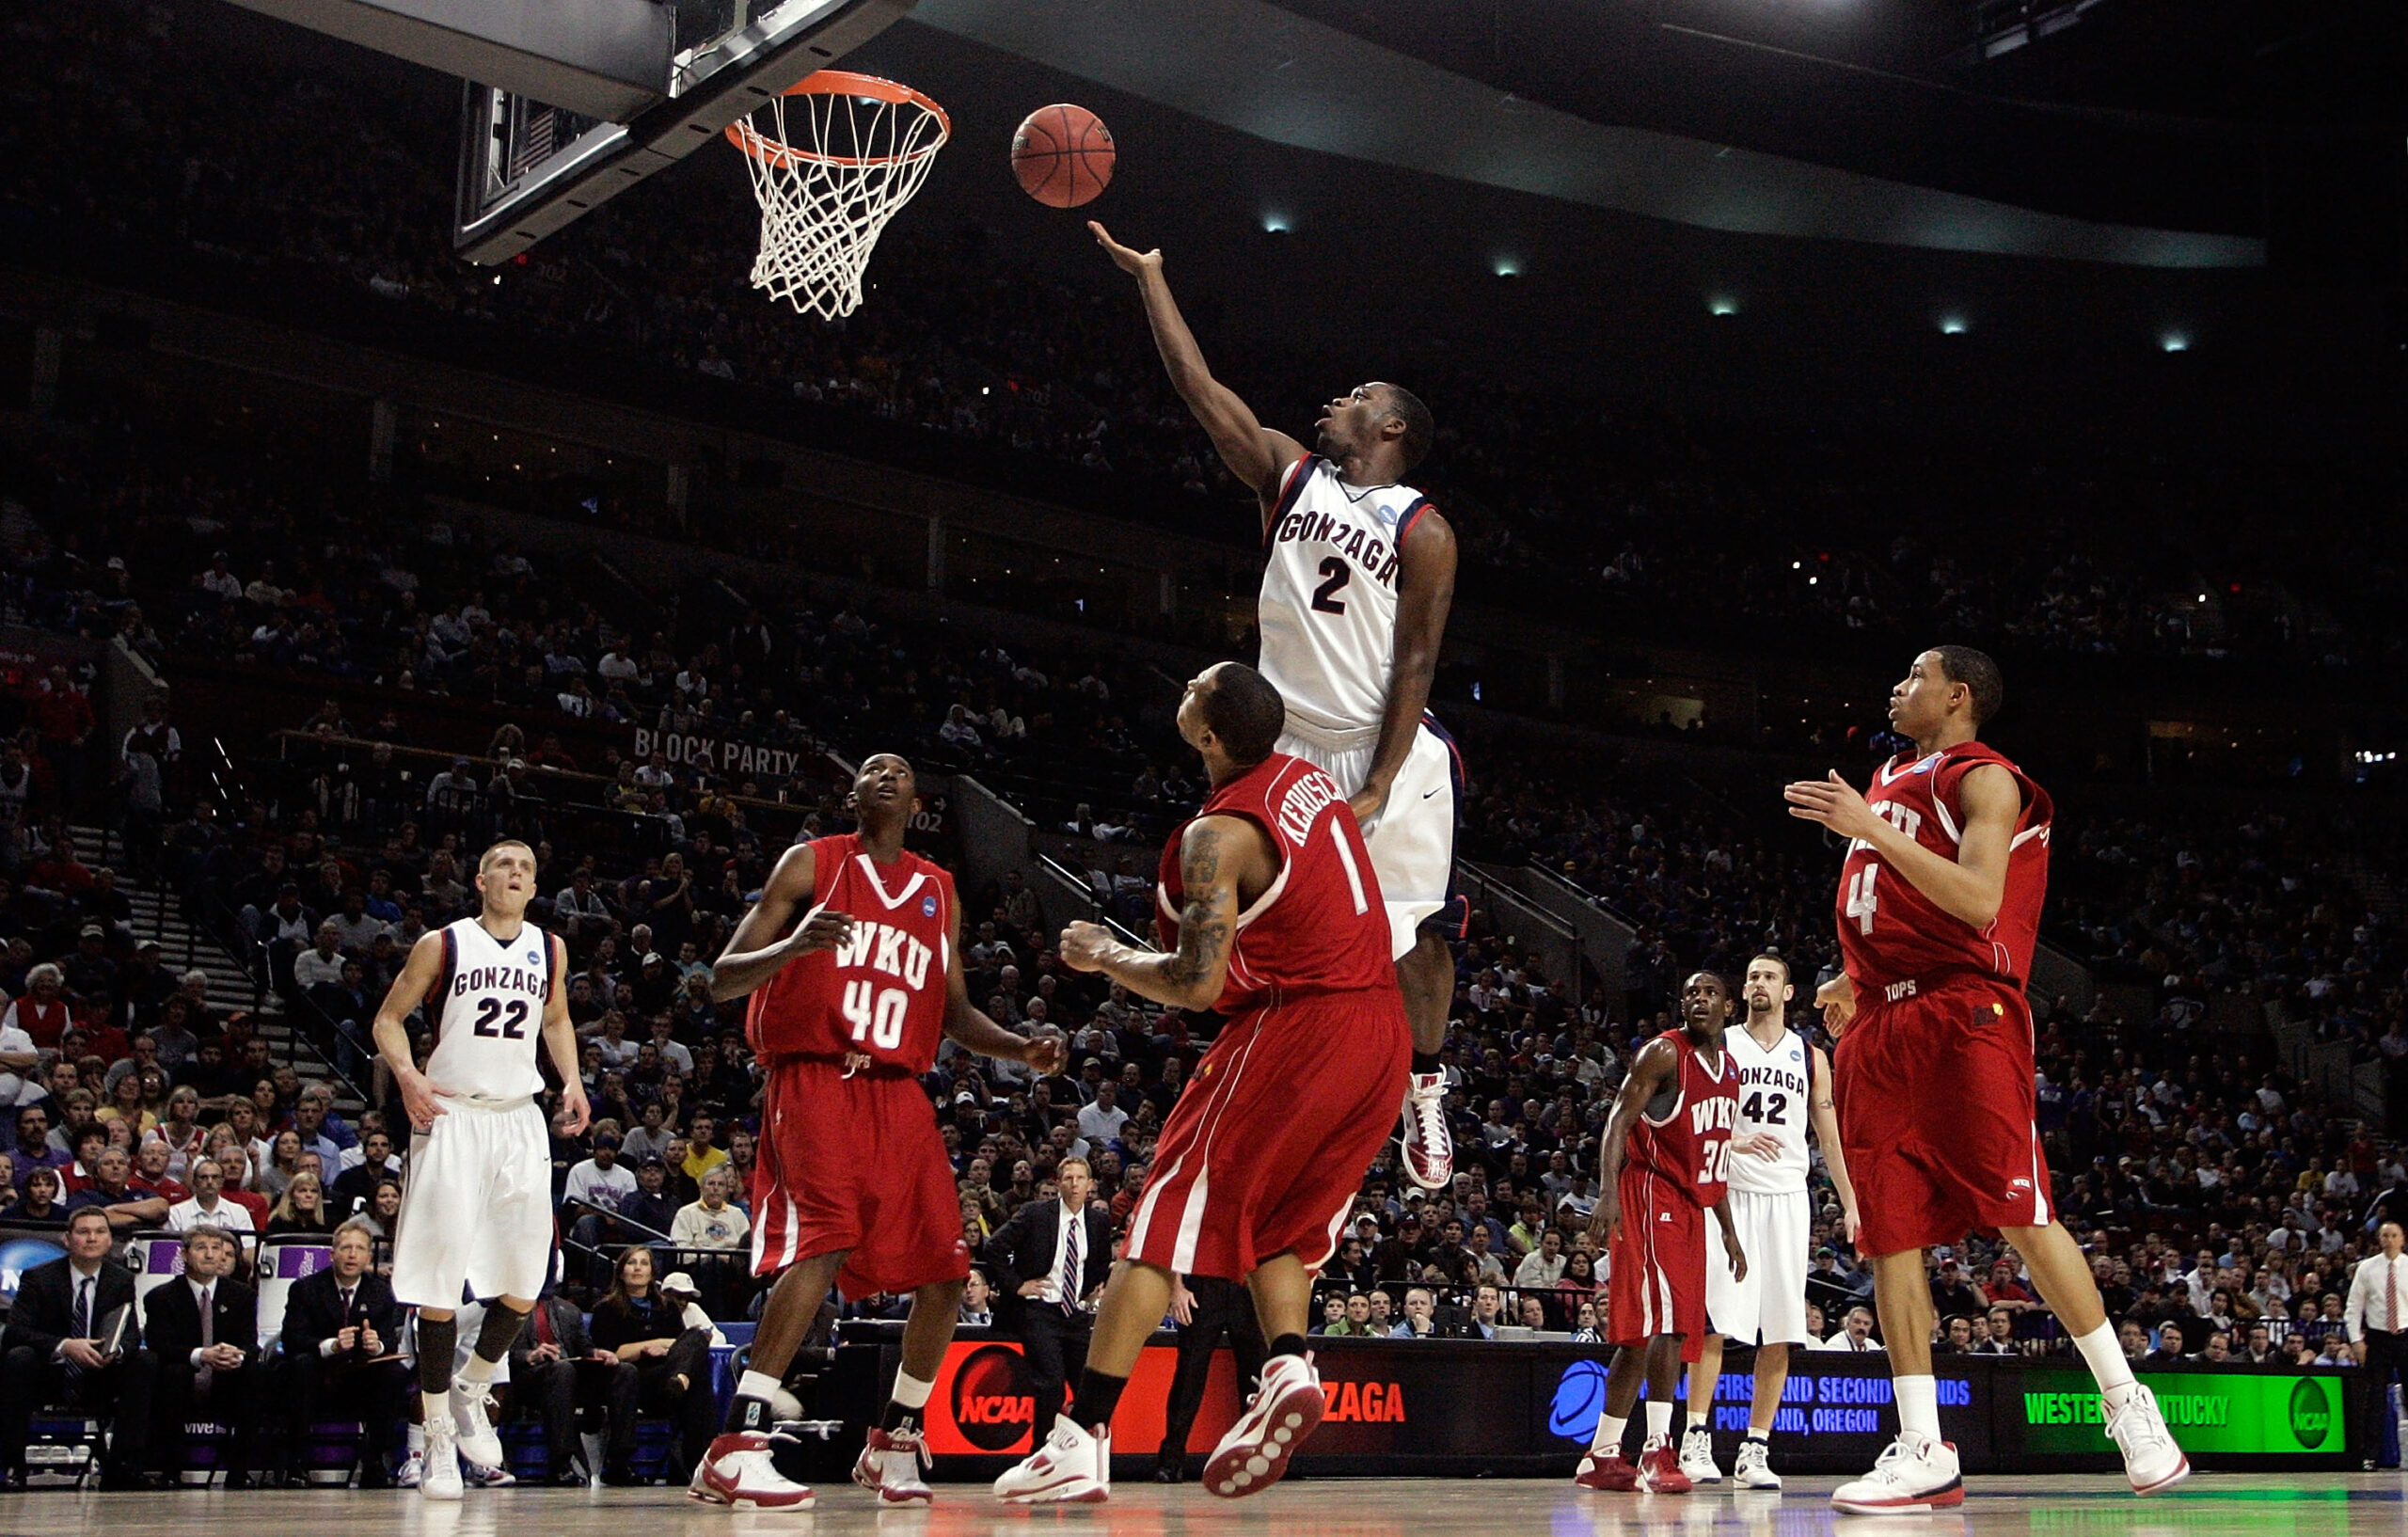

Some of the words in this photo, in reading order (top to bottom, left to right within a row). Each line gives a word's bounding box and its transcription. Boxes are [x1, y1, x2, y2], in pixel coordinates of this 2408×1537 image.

[1278, 511, 1399, 589] GONZAGA
[1311, 556, 1351, 616] 2
[723, 741, 800, 776] PARTY
[1329, 815, 1369, 916] 1
[1846, 863, 1878, 936] 4
[836, 920, 933, 991] WKU
[454, 967, 547, 1000] GONZAGA
[1884, 979, 1917, 1003] TOPS
[473, 997, 529, 1039] 22
[843, 980, 909, 1050] 40
[1739, 1067, 1804, 1099] ONZAGA
[1741, 1091, 1787, 1126] 42
[1697, 1139, 1732, 1184] 30
[1714, 1373, 1755, 1401] FIRS
[1818, 1376, 1892, 1404] SECOND
[1936, 1379, 1972, 1405] NDS
[958, 1394, 1034, 1424] NCAA
[1716, 1406, 1809, 1436] PORAND,
[1812, 1407, 1878, 1434] OREGON
[2024, 1392, 2102, 1425] WESTE
